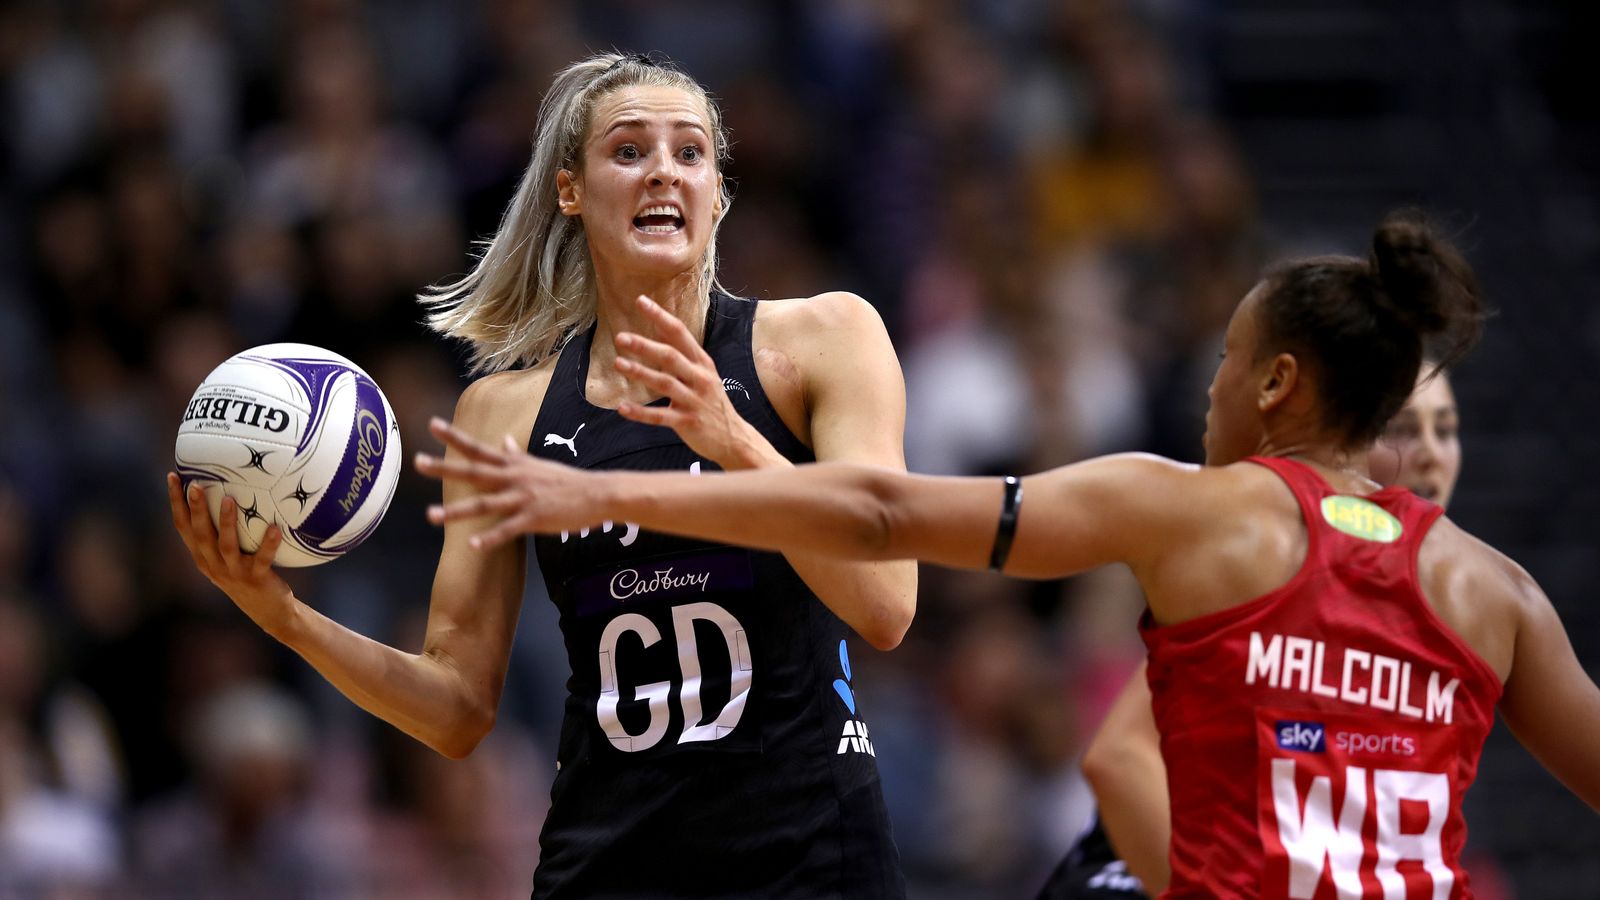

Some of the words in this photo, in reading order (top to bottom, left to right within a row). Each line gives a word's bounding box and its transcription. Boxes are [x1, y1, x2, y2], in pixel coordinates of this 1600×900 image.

[183, 397, 290, 433] GILBER
[338, 408, 384, 512] Cadbury
[609, 566, 710, 600] Cadbury
[596, 601, 753, 753] GD
[1245, 632, 1460, 724] MALCOLM
[836, 719, 876, 758] AN
[1280, 722, 1323, 752] sky
[1335, 731, 1415, 756] sports
[1270, 757, 1455, 900] WA
